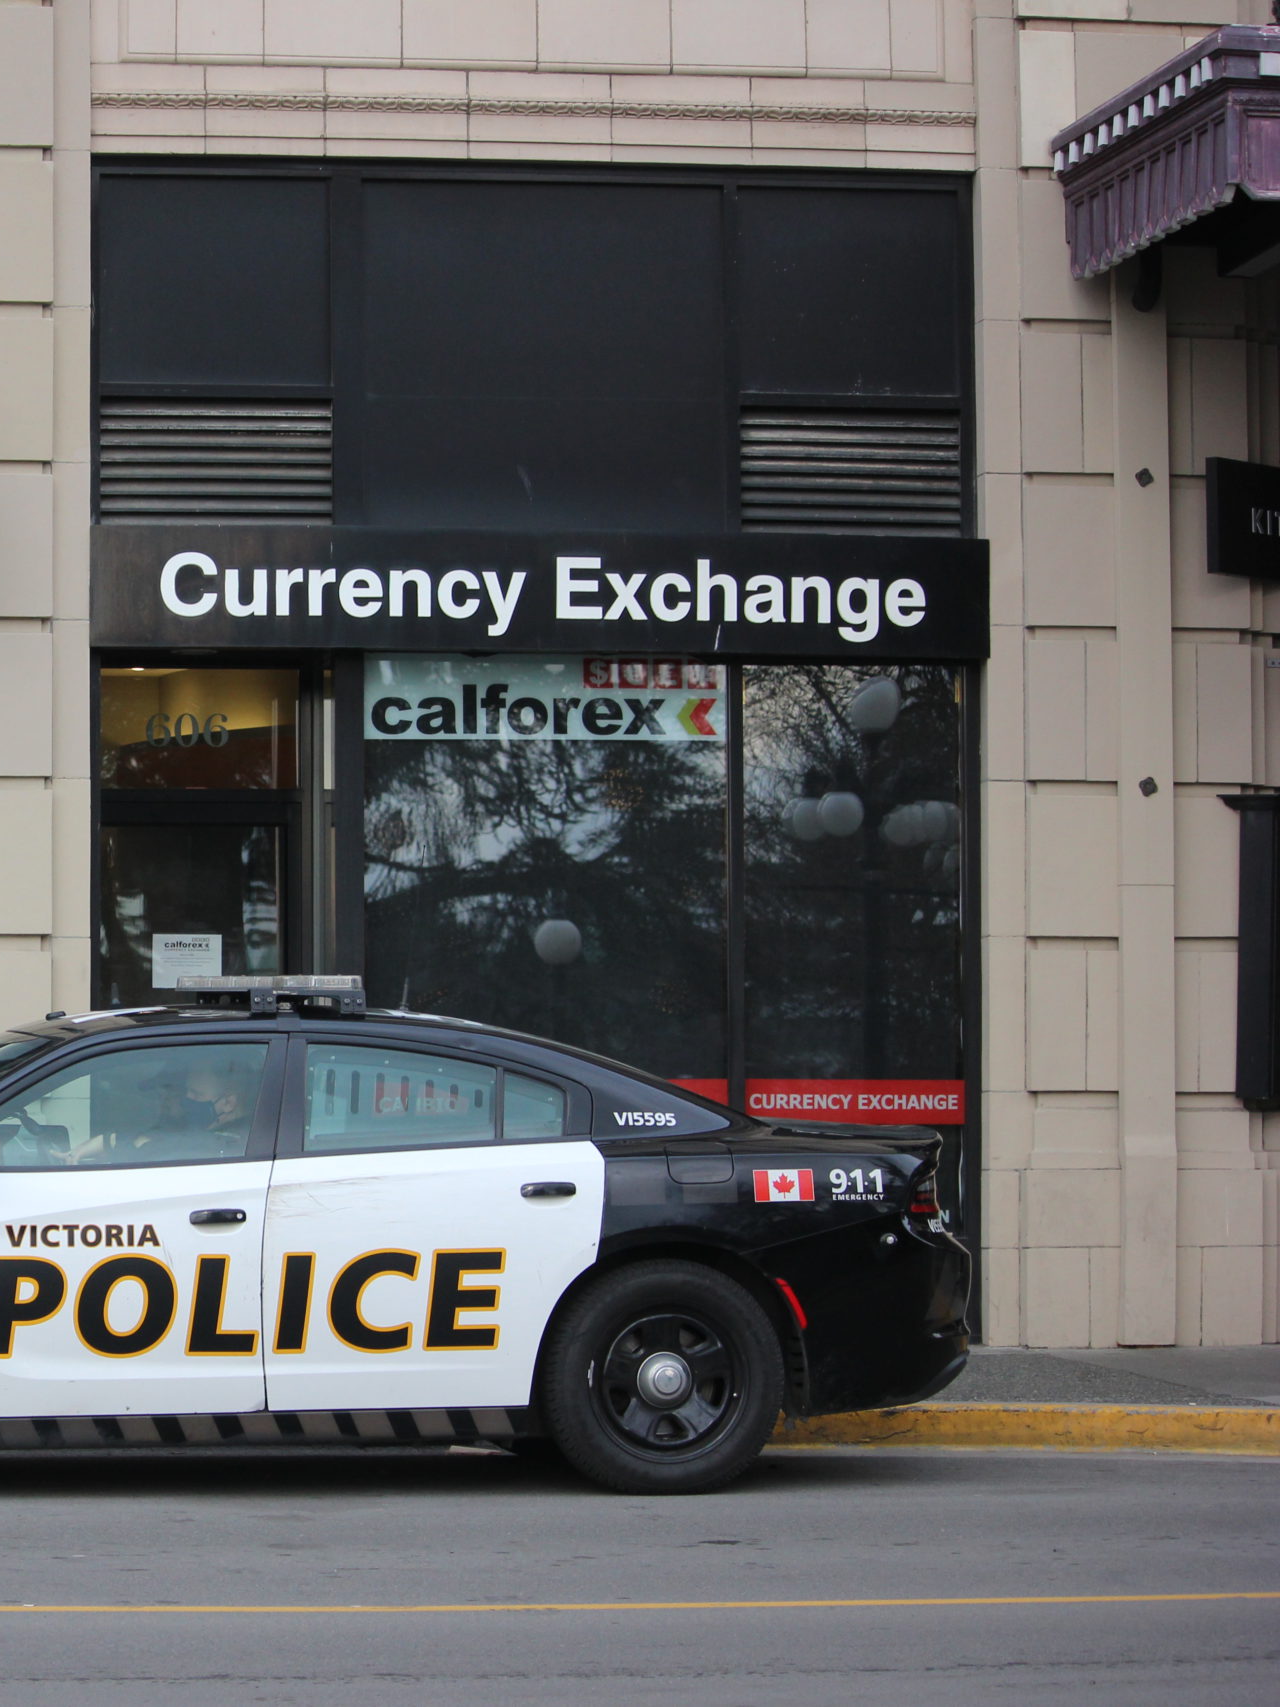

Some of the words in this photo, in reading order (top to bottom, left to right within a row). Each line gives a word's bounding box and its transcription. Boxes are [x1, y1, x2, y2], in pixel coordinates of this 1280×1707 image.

[159, 551, 525, 637] Currency
[555, 556, 927, 644] Exchange
[371, 684, 666, 735] calforex
[146, 713, 229, 748] 606
[164, 940, 203, 948] calforex
[749, 1093, 853, 1110] CURRENCY
[857, 1094, 959, 1110] EXCHANGE
[613, 1111, 677, 1127] VI5595
[832, 1193, 885, 1201] EMERGENCY
[5, 1224, 160, 1248] VICTORIA
